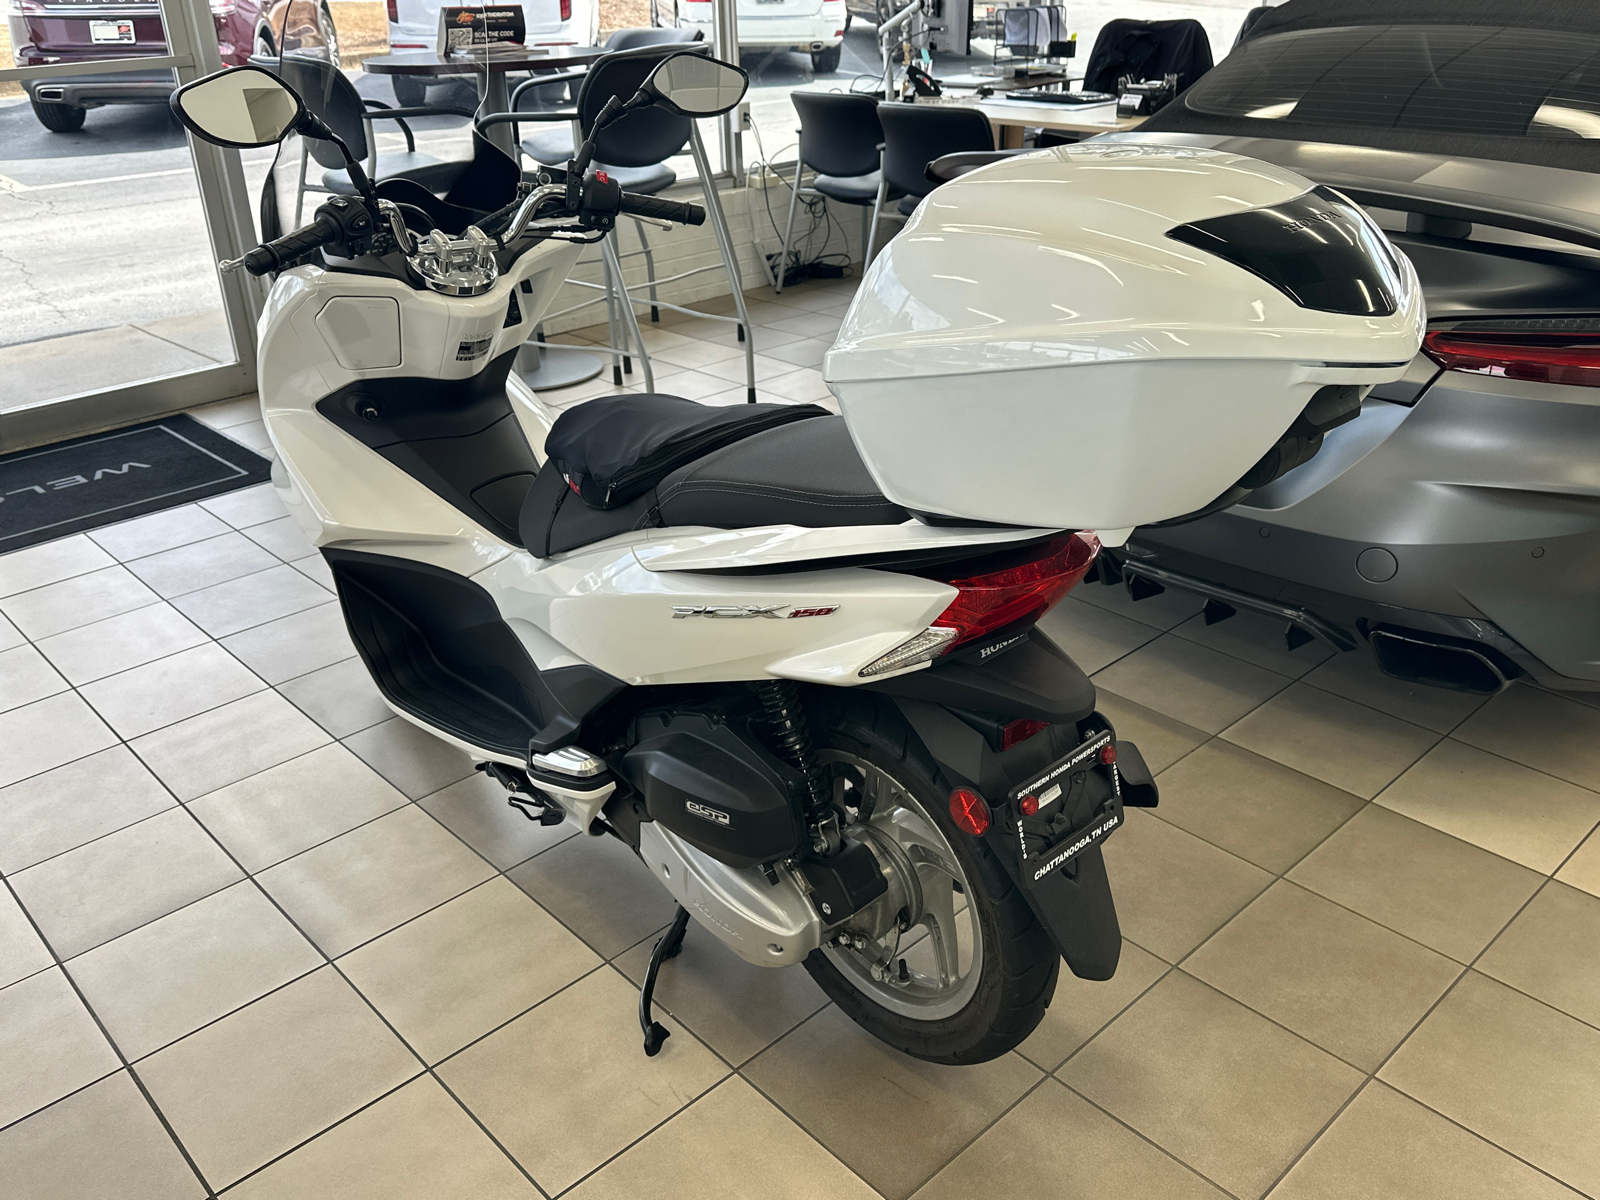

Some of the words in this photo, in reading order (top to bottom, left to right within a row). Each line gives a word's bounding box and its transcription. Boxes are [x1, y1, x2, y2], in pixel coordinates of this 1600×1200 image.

[1282, 211, 1342, 234] HONDA
[0, 462, 152, 504] WEL
[669, 604, 791, 619] PCX
[786, 604, 841, 619] 150
[1017, 774, 1050, 800] SOUTHERN
[1050, 762, 1071, 780] HONDA
[1071, 735, 1111, 766] POWERSPORTS
[1103, 816, 1118, 831] USA
[1016, 820, 1028, 860] WORLD'S
